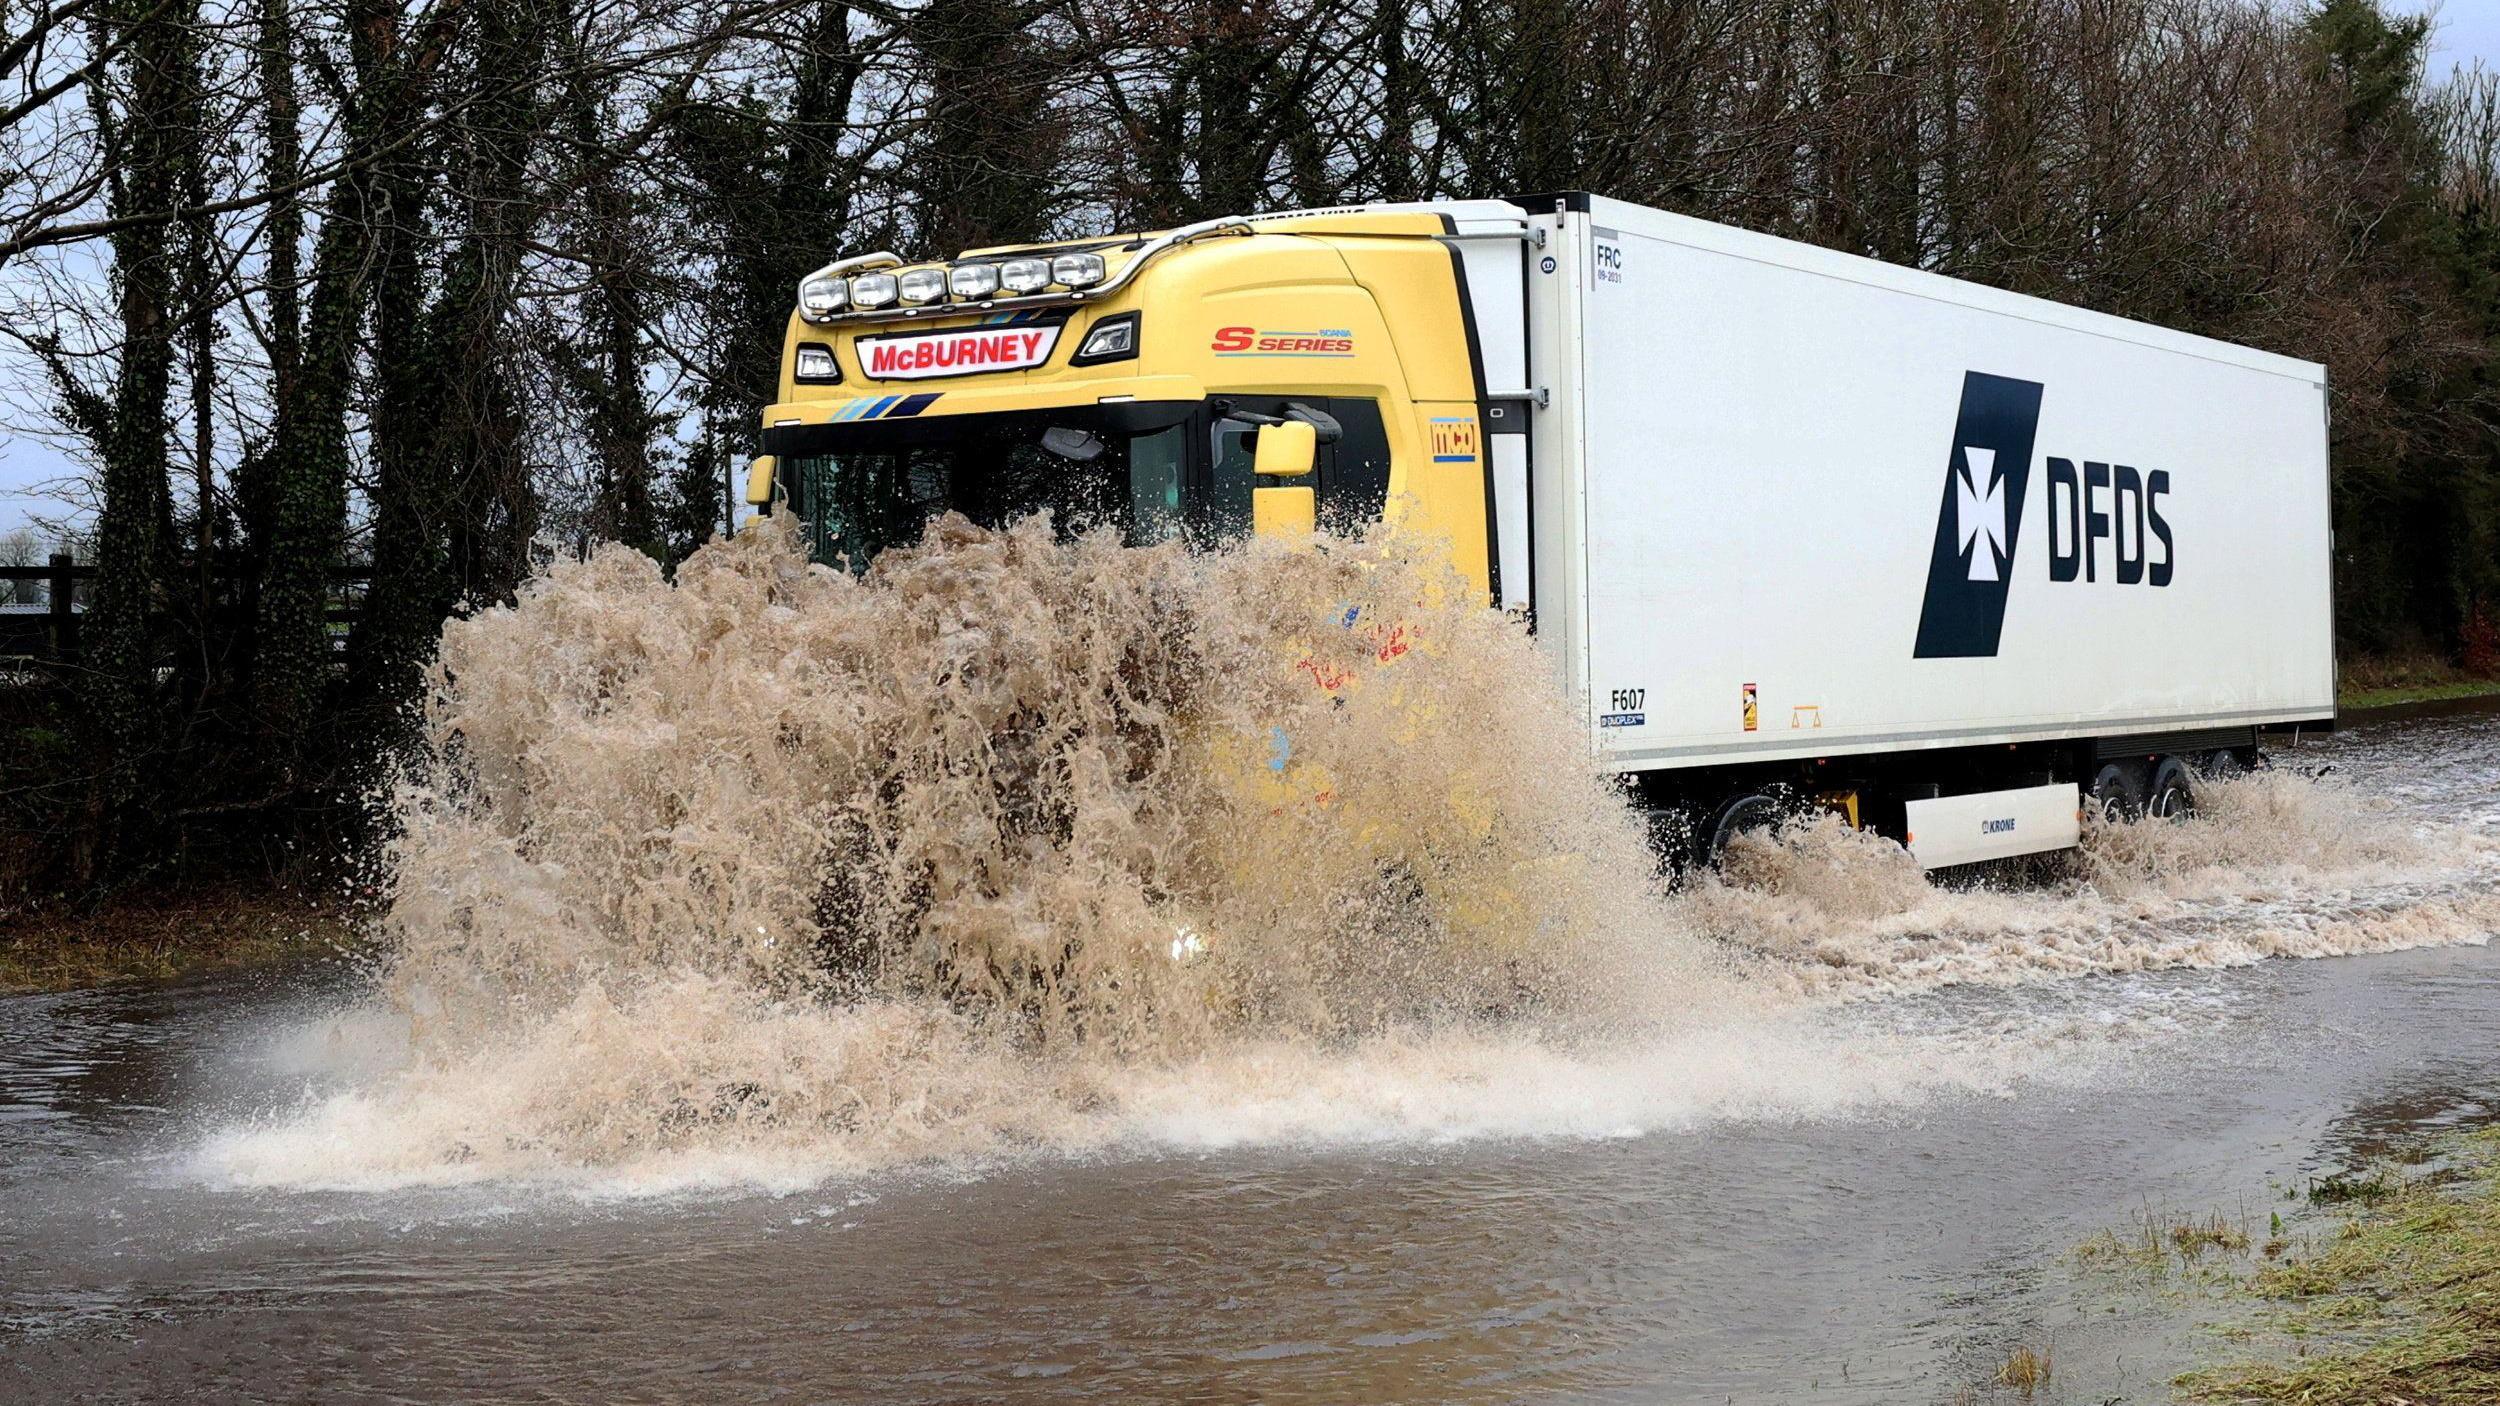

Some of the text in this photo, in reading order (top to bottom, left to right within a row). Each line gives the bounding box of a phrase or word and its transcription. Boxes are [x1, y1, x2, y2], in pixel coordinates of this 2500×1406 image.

[1597, 245, 1621, 269] FRC
[1211, 327, 1353, 351] S SERIES
[1319, 329, 1352, 337] SCANIA
[871, 332, 1043, 373] McBURNEY
[2046, 456, 2174, 588] DFDS
[1612, 688, 1645, 711] F607
[1989, 818, 2015, 833] KRONE
